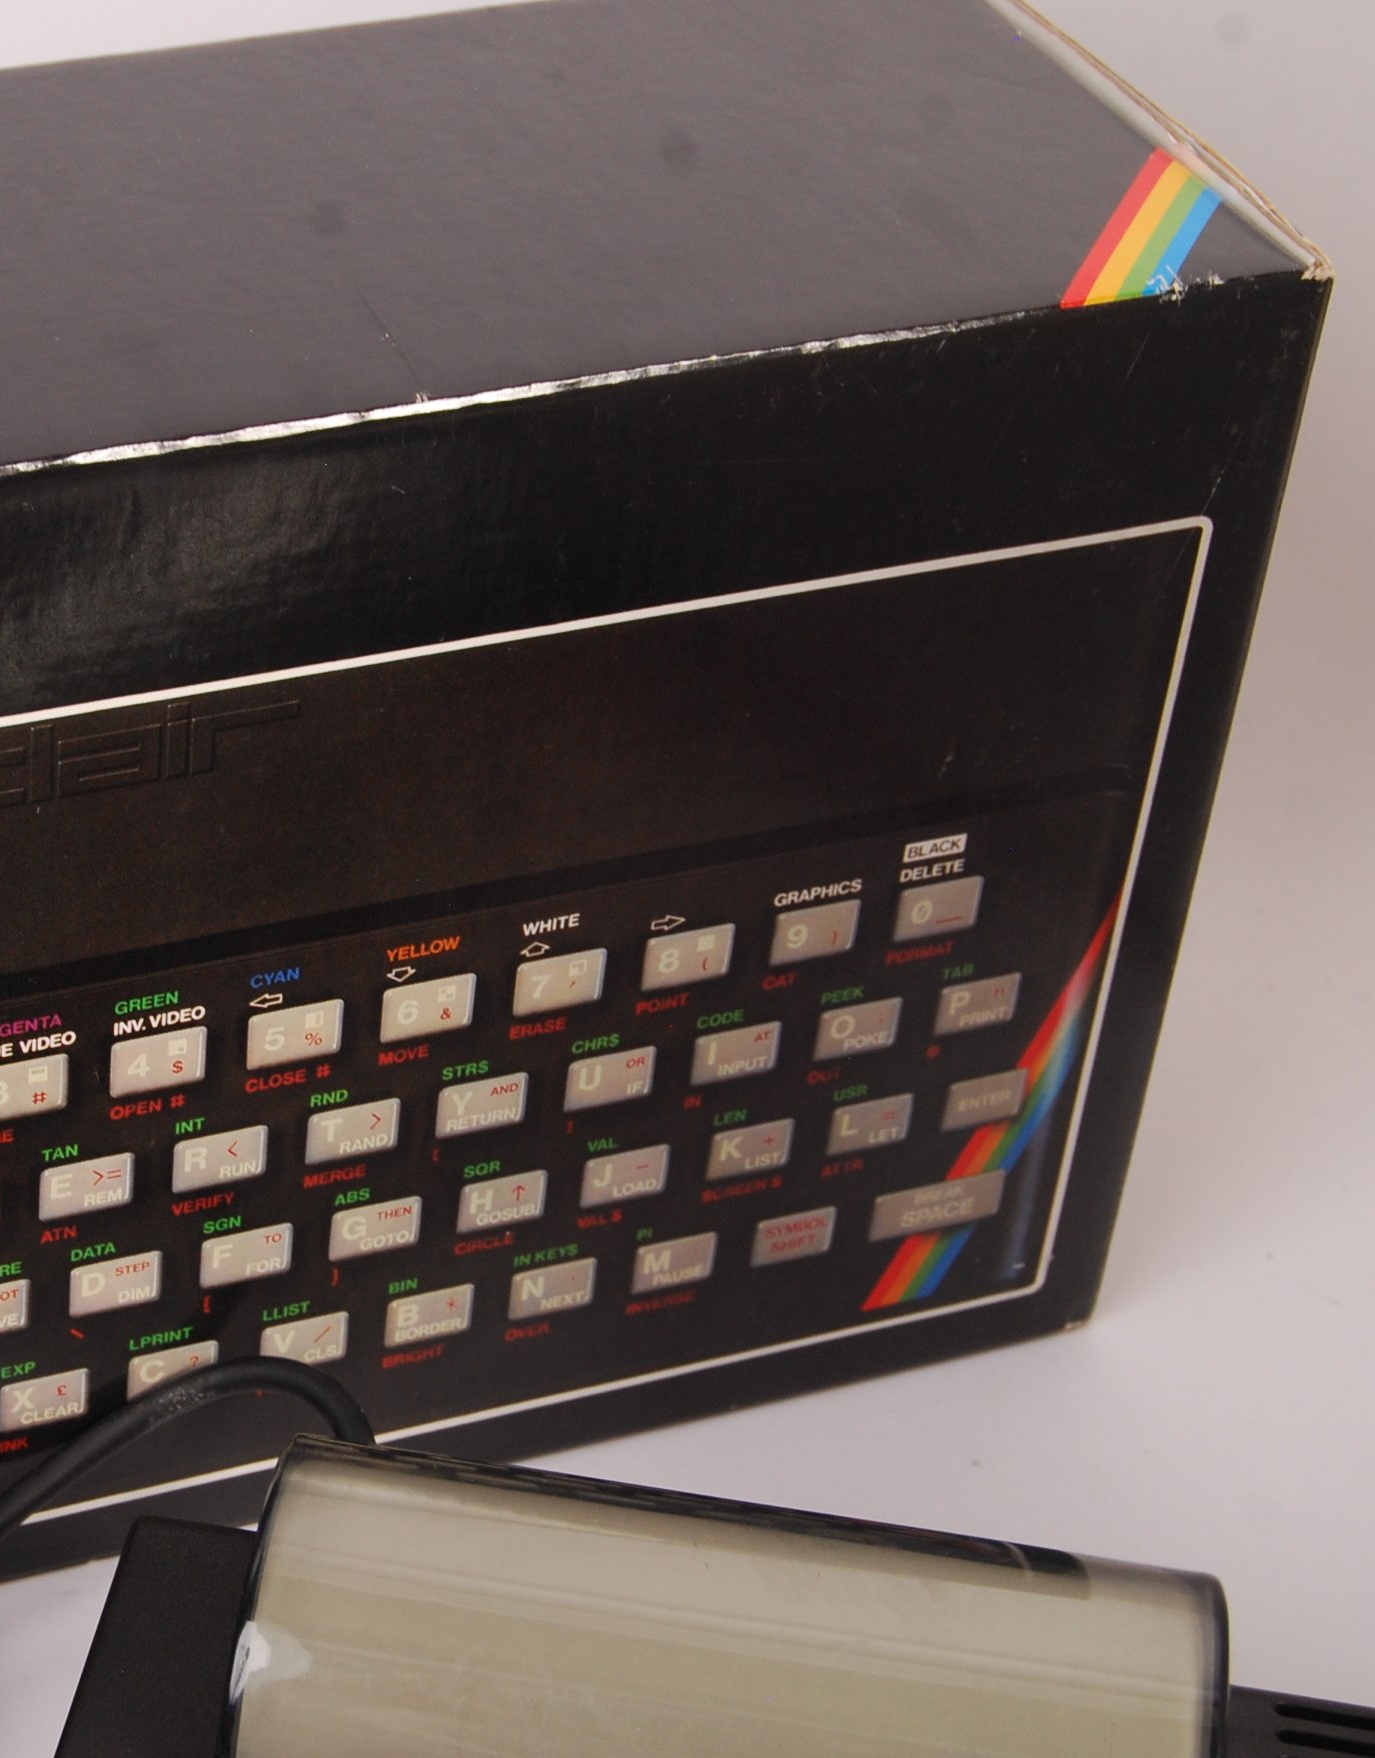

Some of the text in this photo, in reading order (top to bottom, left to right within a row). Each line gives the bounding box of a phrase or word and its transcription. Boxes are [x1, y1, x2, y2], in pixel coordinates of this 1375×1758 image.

[907, 838, 961, 859] BLACK
[900, 859, 965, 882] DELETE
[775, 879, 862, 907] GRAPHICS
[523, 913, 580, 936] WHITE
[786, 924, 808, 948] 9
[387, 936, 460, 962] YELLOW
[658, 948, 680, 972] 8
[249, 968, 300, 989] CYAN
[763, 972, 797, 990] CAT
[942, 964, 974, 980] TAB
[532, 974, 551, 998] 7
[821, 987, 864, 1005] PEEK
[115, 991, 179, 1015] GREEN
[397, 1000, 418, 1024] 6
[636, 993, 689, 1015] POINT
[950, 992, 970, 1015] P
[114, 1006, 206, 1037] INV. VIDEO
[697, 1010, 744, 1029] CODE
[831, 1015, 855, 1039] O
[960, 1006, 1007, 1027] PRINT
[264, 1026, 285, 1051] 5
[510, 1018, 566, 1040] ERASE
[754, 1031, 770, 1043] AT
[20, 1031, 76, 1053] VIDEO
[844, 1031, 888, 1050] POKE
[127, 1055, 150, 1077] 4
[378, 1045, 429, 1066] MOVE
[626, 1057, 645, 1068] OR
[718, 1056, 767, 1076] INPUT
[245, 1070, 306, 1093] CLOSE
[579, 1065, 603, 1090] U
[627, 1082, 643, 1094] IF
[310, 1090, 348, 1107] RND
[491, 1083, 519, 1097] AND
[110, 1100, 162, 1120] OPEN
[453, 1092, 472, 1115] Y
[175, 1117, 205, 1134] INT
[321, 1118, 343, 1142] T
[446, 1108, 516, 1133] RETURN
[840, 1115, 858, 1137] L
[42, 1145, 78, 1162] TAN
[340, 1134, 387, 1154] RAND
[588, 1138, 618, 1152] VAL
[720, 1137, 743, 1161] K
[184, 1147, 207, 1172] R
[220, 1162, 256, 1179] RUN
[463, 1161, 500, 1179] SQR
[745, 1153, 781, 1170] LIST
[51, 1174, 73, 1199] E
[303, 1165, 367, 1188] MERGE
[594, 1163, 613, 1188] J
[84, 1189, 121, 1207] REM
[334, 1188, 370, 1206] ABS
[613, 1179, 657, 1197] LOAD
[174, 1193, 234, 1216] VERIFY
[469, 1189, 493, 1214] H
[377, 1206, 412, 1221] THEN
[476, 1204, 535, 1226] GOSUB
[901, 1198, 973, 1228] SPACE
[41, 1226, 77, 1244] ATN
[203, 1216, 242, 1234] SGN
[341, 1217, 367, 1240] G
[265, 1233, 282, 1245] TO
[360, 1231, 409, 1251] GOTO
[455, 1235, 514, 1256] CIRCLE
[71, 1242, 115, 1262] DATA
[212, 1245, 233, 1269] F
[115, 1262, 150, 1276] STEP
[246, 1259, 281, 1276] FOR
[644, 1253, 670, 1275] M
[82, 1272, 106, 1297] D
[389, 1278, 418, 1294] BIN
[653, 1266, 704, 1285] PAUSE
[118, 1287, 150, 1303] DIM
[521, 1276, 544, 1300] N
[541, 1291, 585, 1310] NEXT
[263, 1302, 310, 1322] LLIST
[397, 1304, 419, 1328] B
[129, 1327, 193, 1351] LPRINT
[273, 1330, 295, 1353] V
[394, 1319, 460, 1342] BORDER
[305, 1345, 338, 1362] CLS
[382, 1345, 444, 1369] BRIGHT
[0, 1362, 35, 1379] EXP
[140, 1360, 165, 1382] C
[12, 1388, 35, 1412] X
[21, 1403, 77, 1425] CLEAR
